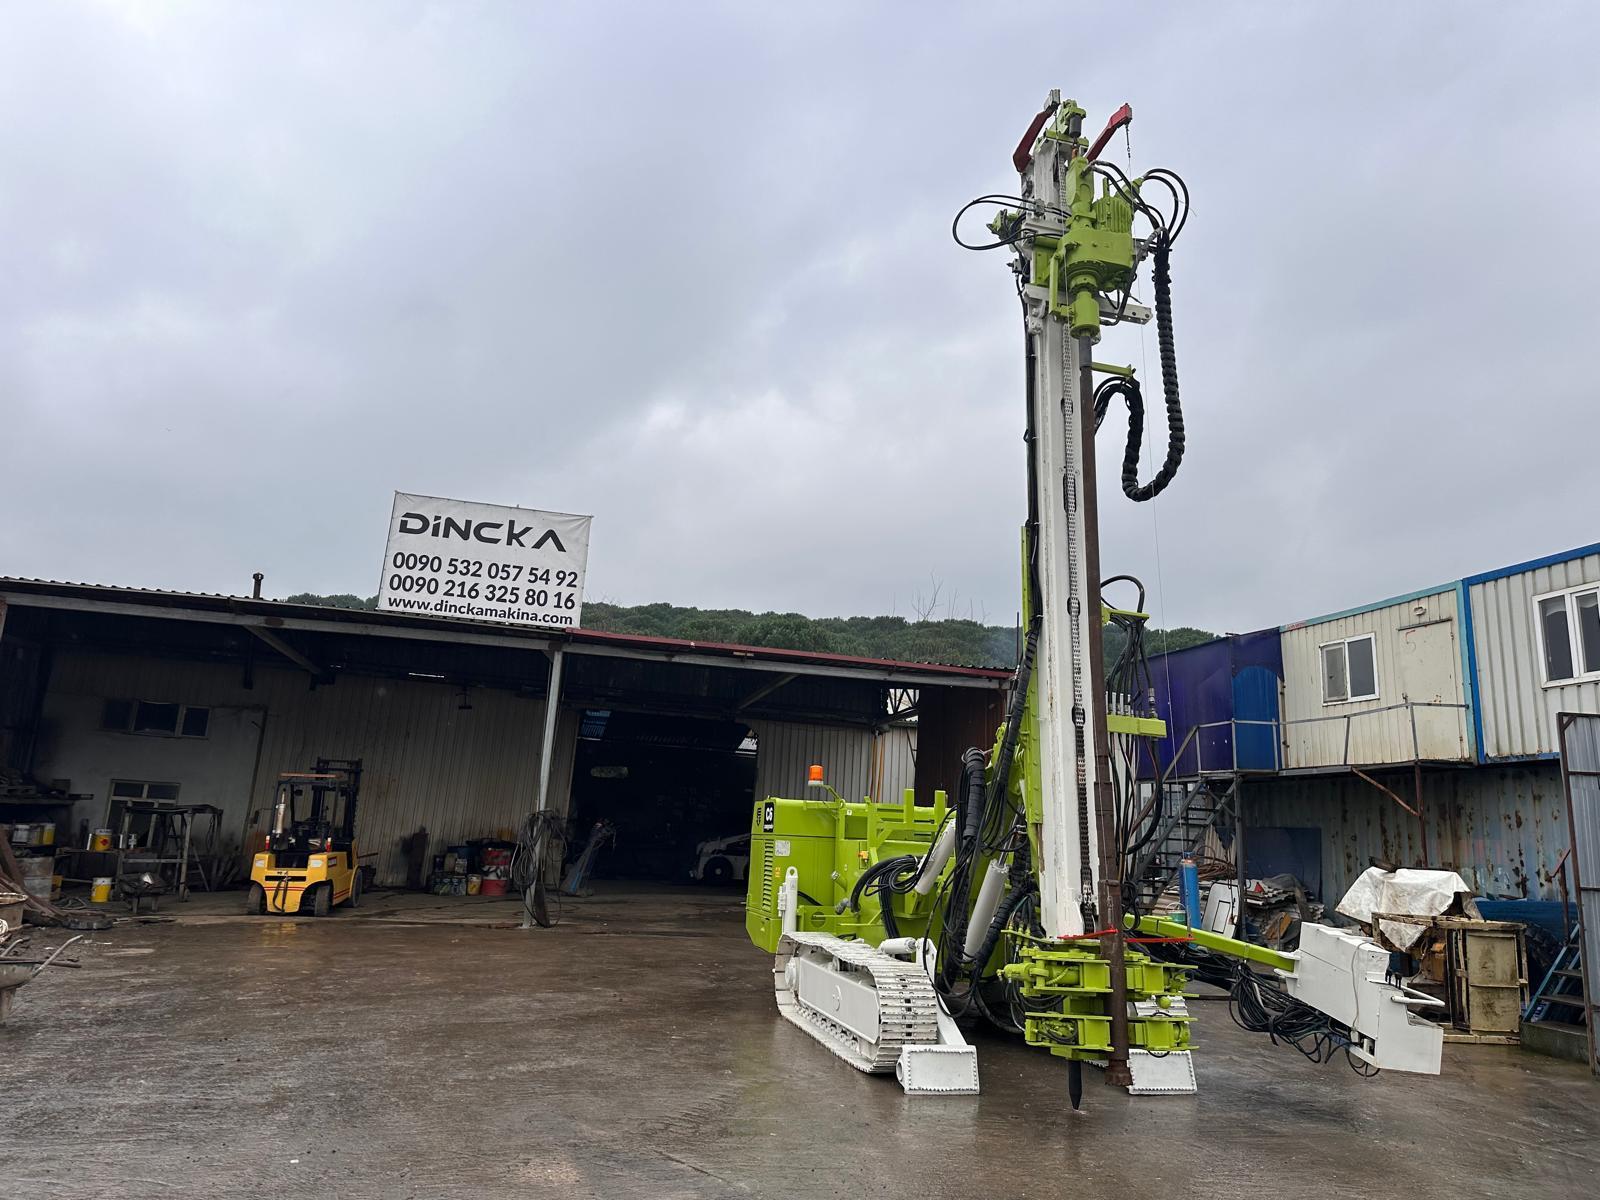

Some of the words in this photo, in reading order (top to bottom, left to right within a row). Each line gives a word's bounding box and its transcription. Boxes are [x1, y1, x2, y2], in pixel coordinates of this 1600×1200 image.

[392, 551, 443, 573] 0090
[446, 557, 483, 578] 532
[487, 562, 524, 582] 057
[527, 566, 551, 585] 54
[555, 570, 578, 589] 92
[389, 573, 439, 595] 0090
[442, 579, 480, 600] 216
[484, 584, 520, 605] 325
[524, 588, 549, 607] 80
[553, 592, 576, 610] 16
[388, 597, 572, 625] www.dinckamakina.com
